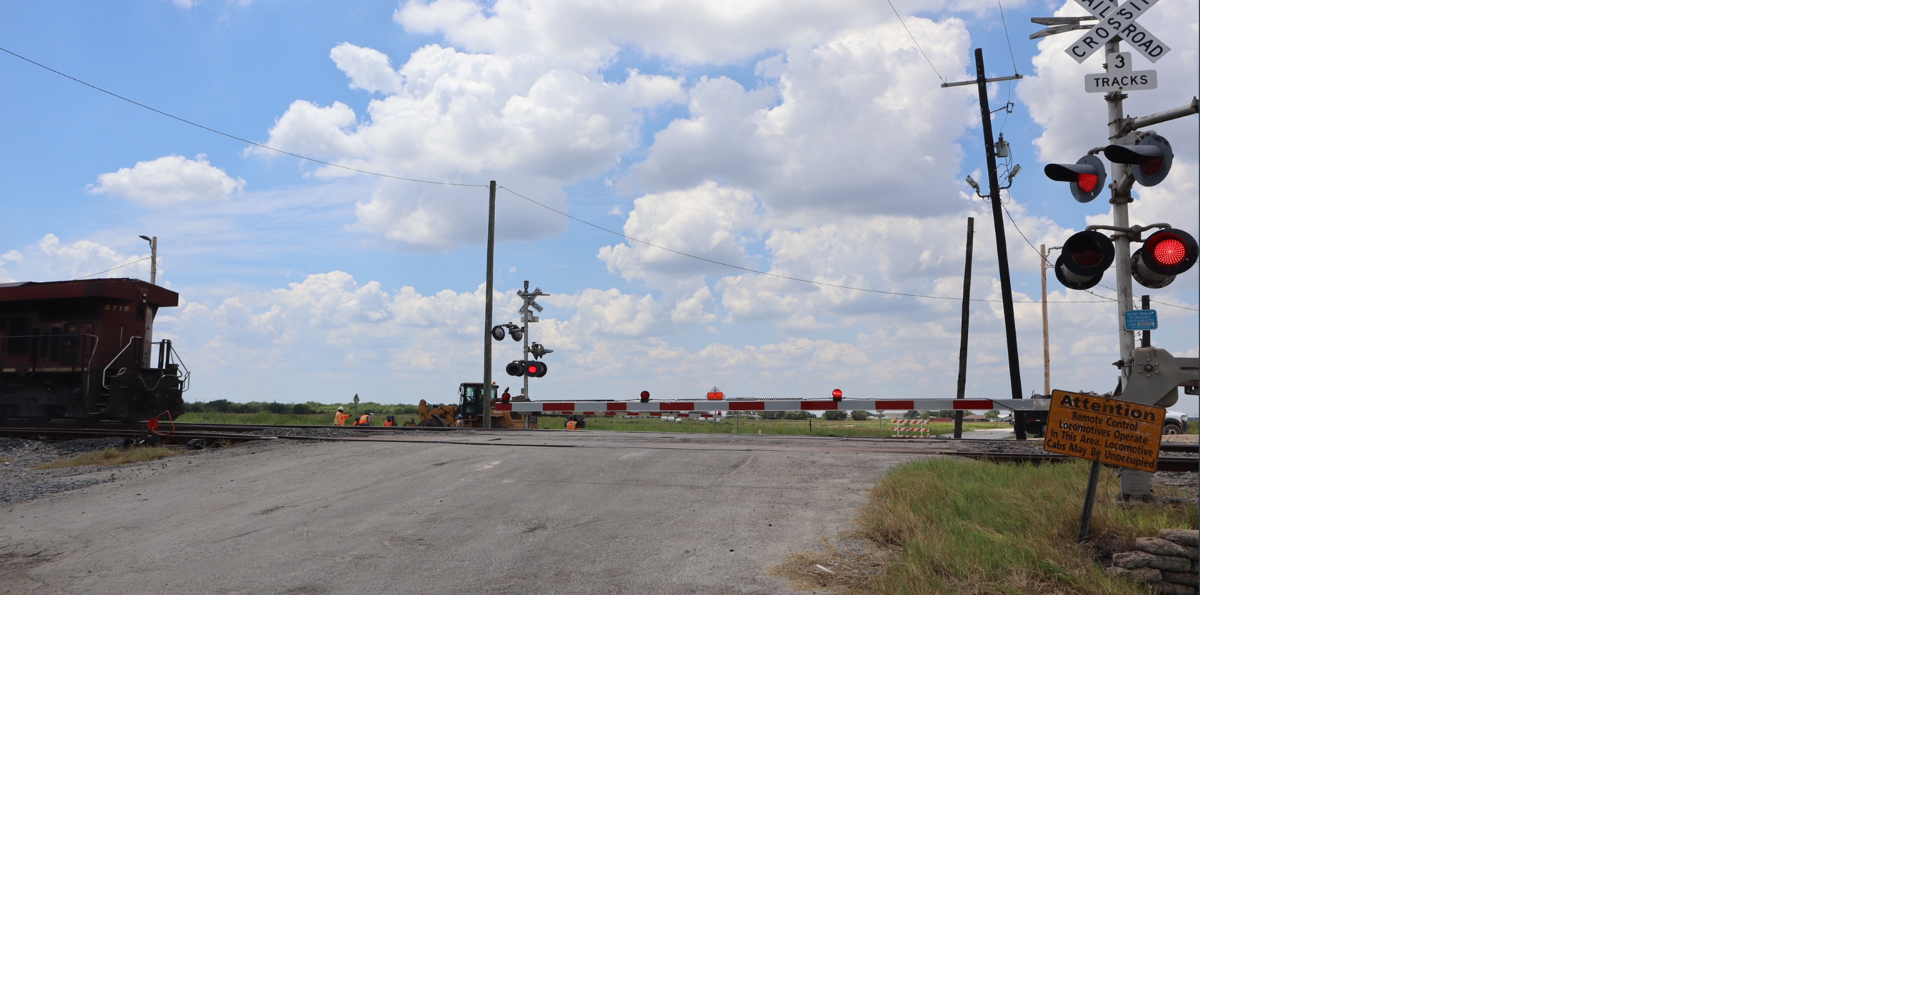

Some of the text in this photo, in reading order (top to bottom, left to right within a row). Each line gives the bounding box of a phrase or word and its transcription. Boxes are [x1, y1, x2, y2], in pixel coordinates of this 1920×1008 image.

[1072, 0, 1149, 57] CROSSI
[1114, 54, 1125, 69] 3
[1094, 75, 1148, 88] TRACKS
[1060, 394, 1156, 421] Attention
[1059, 420, 1148, 445] Locomotives Operate
[1072, 411, 1138, 432] Remote Control
[1046, 439, 1156, 469] Cabs May Be Unoccupied
[1050, 429, 1154, 457] In This Area. Locomotive
